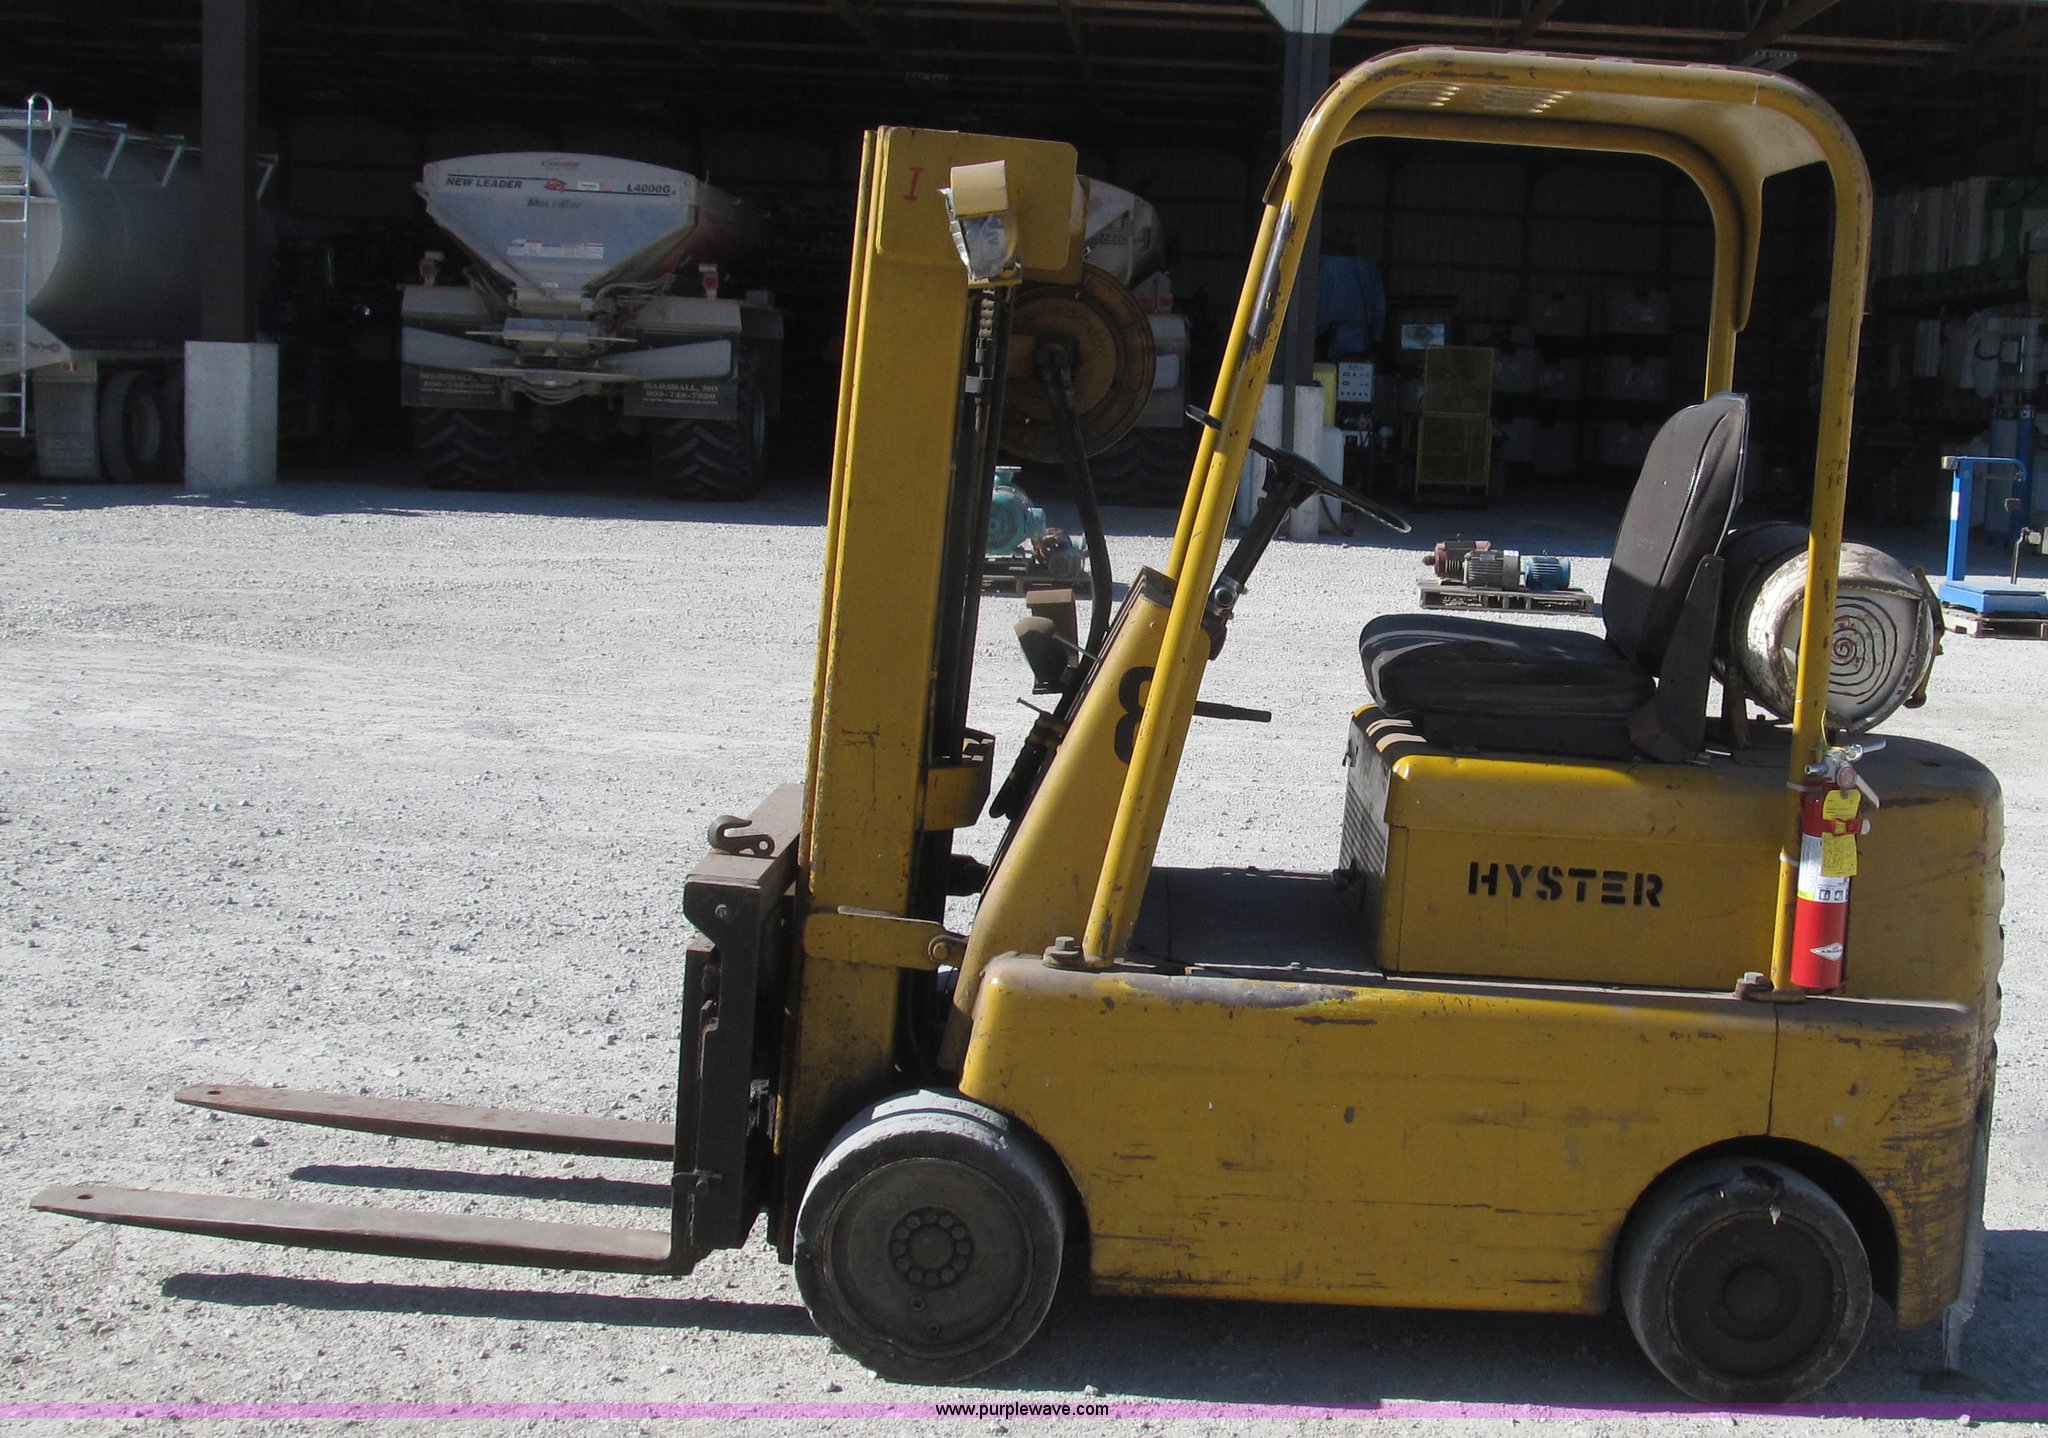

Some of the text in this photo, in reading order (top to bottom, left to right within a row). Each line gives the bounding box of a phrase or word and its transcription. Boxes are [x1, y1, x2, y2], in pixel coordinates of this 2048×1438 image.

[446, 177, 523, 189] NEW LEADER
[1468, 861, 1663, 906] HYSTER
